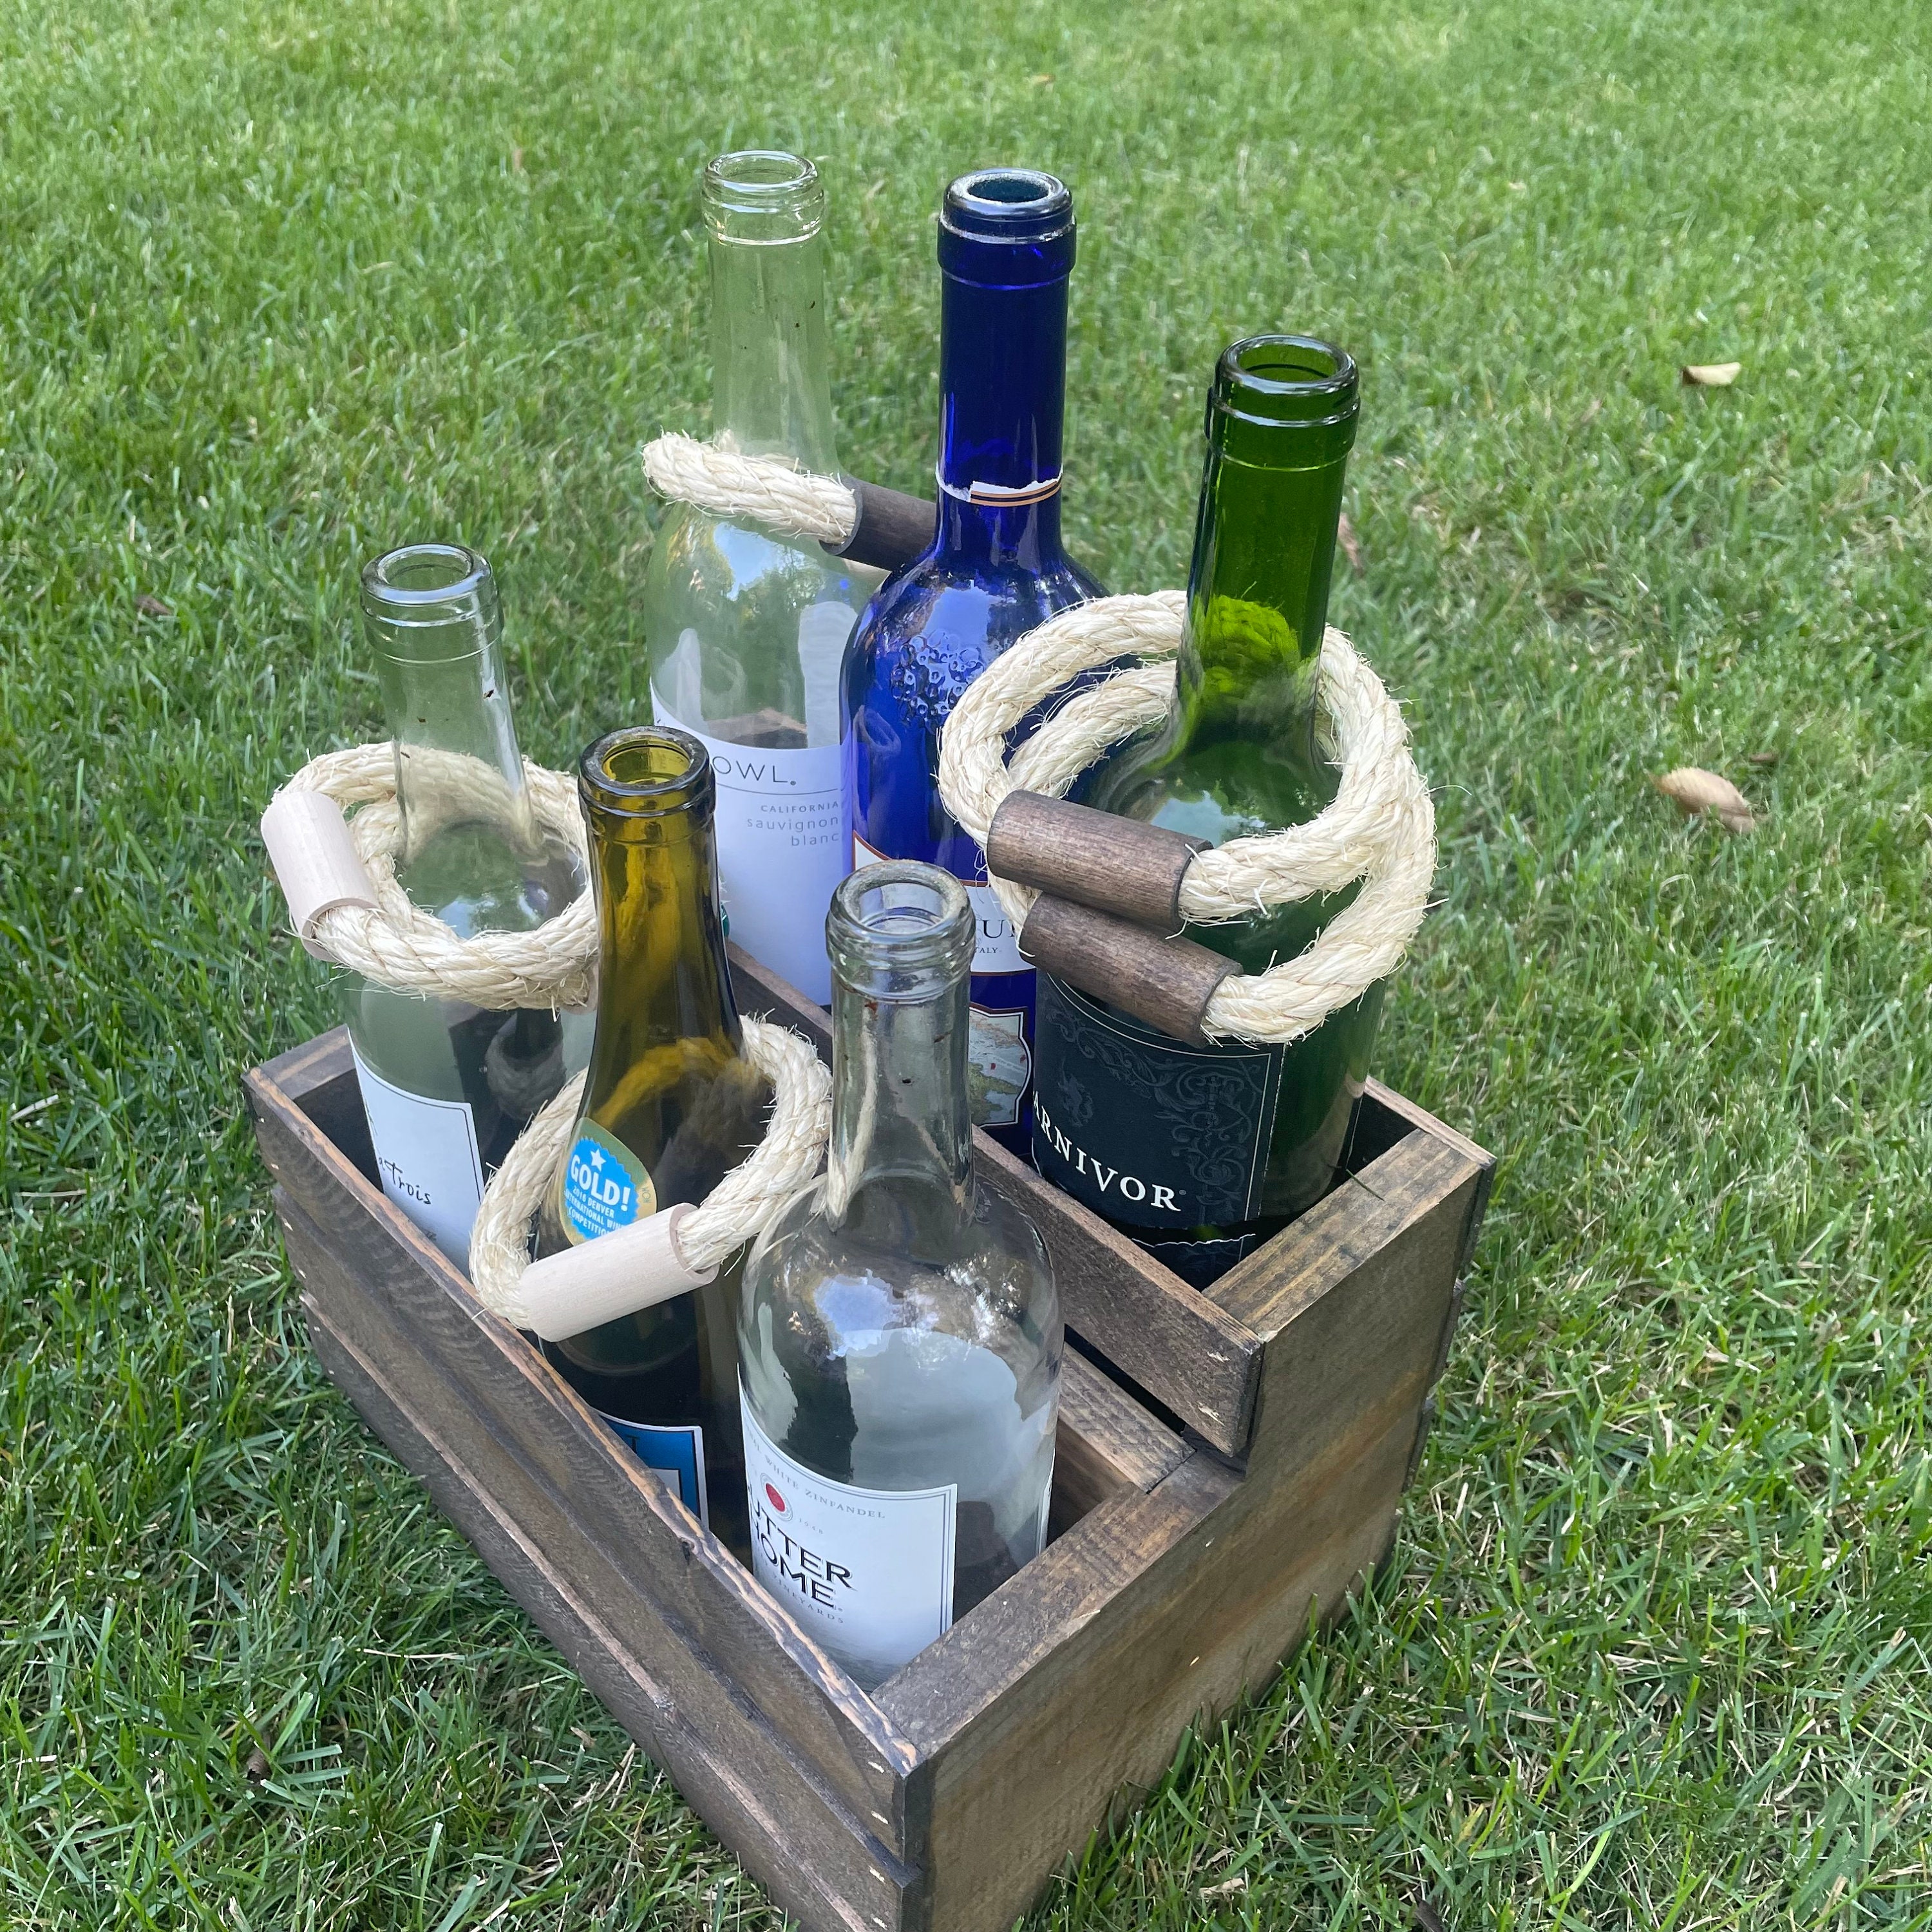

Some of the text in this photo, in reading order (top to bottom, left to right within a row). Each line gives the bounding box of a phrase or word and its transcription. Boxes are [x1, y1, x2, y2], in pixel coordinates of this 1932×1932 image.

[761, 801, 839, 813] CALIFORNIA
[747, 816, 839, 833] sauvignon
[791, 833, 840, 847] blanc
[1032, 1090, 1182, 1211] ARNIVOR
[571, 1154, 630, 1212] GOLD!
[568, 1206, 610, 1236] COMPETITIO
[587, 1197, 615, 1219] DENVER
[805, 1488, 886, 1519] ZINFANDEL
[748, 1482, 858, 1593] UTTER
